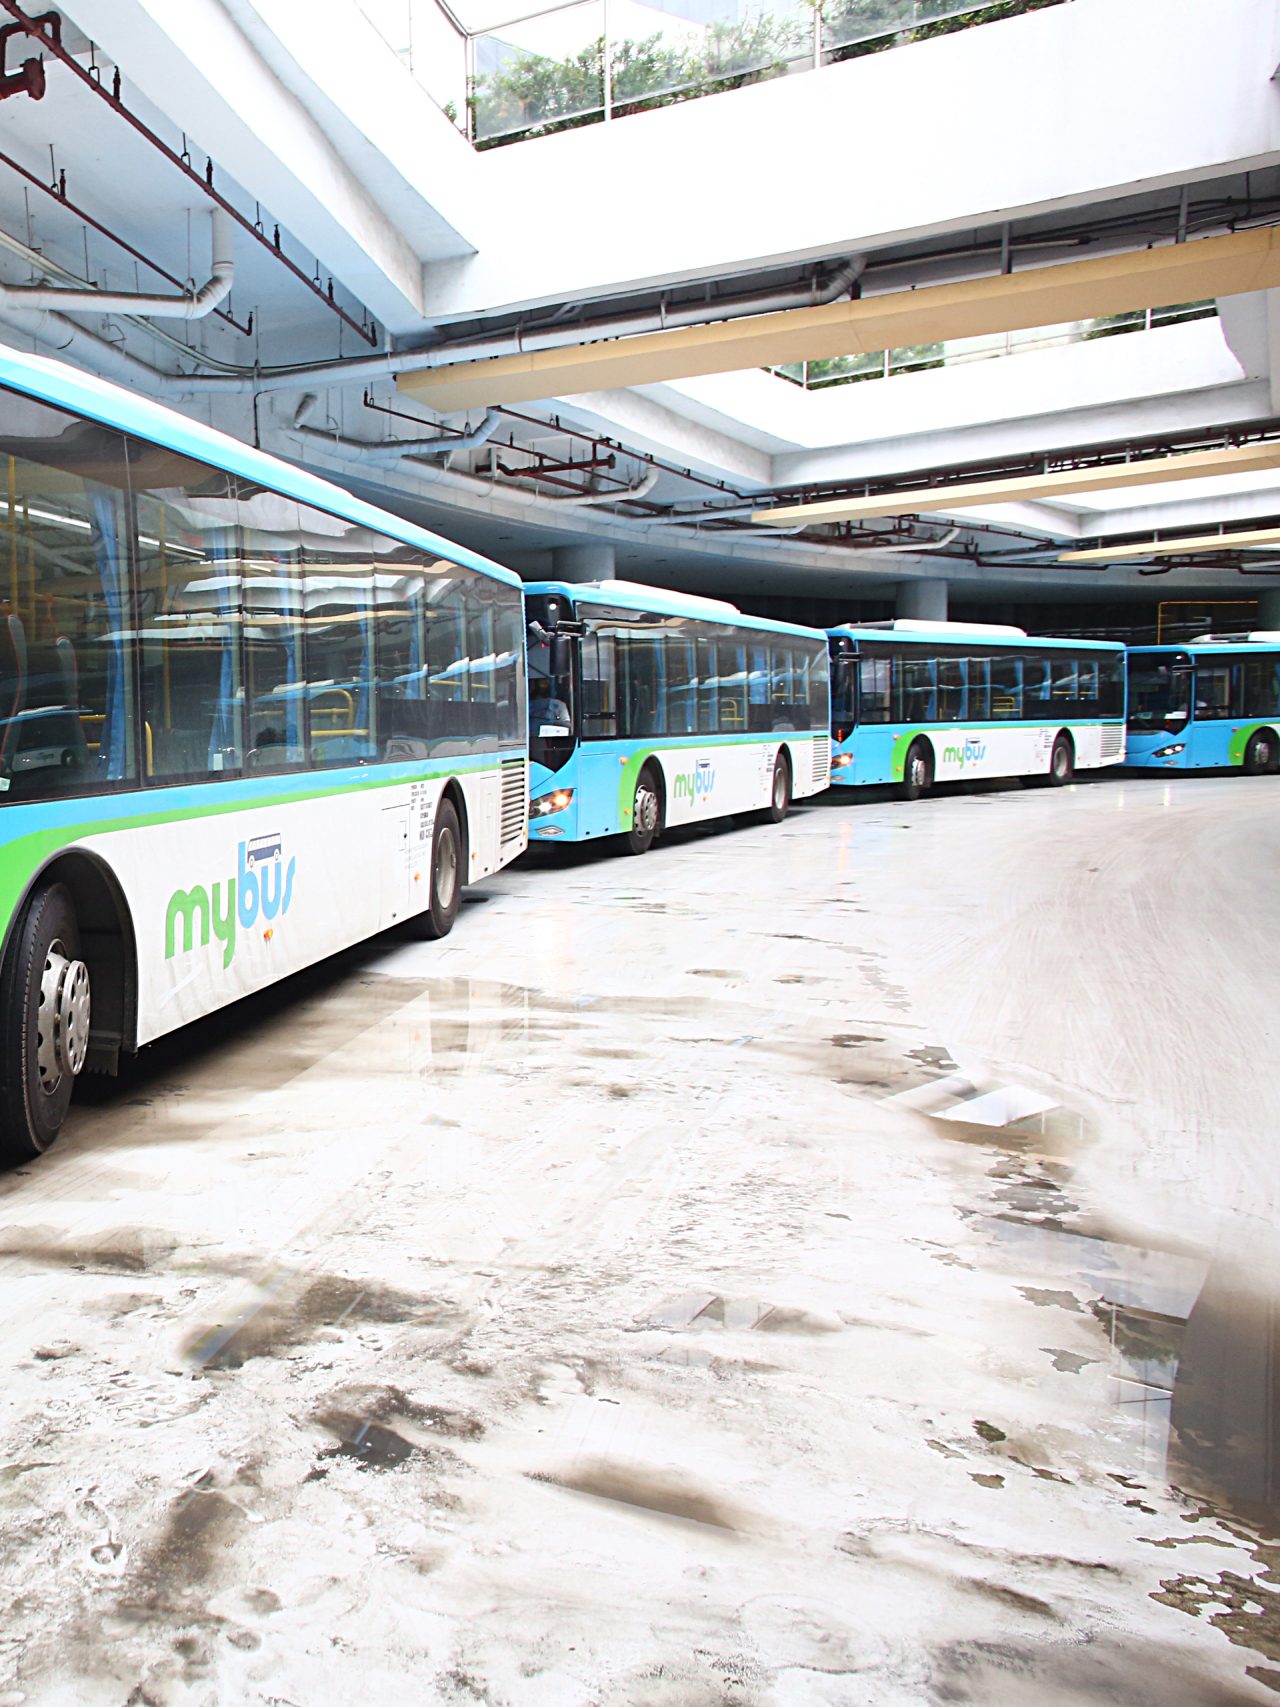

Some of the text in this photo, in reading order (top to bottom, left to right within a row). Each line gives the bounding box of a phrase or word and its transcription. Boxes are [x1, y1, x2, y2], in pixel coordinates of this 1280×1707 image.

[943, 738, 986, 769] mybus
[674, 759, 715, 807] mybus
[165, 840, 296, 970] mybus
